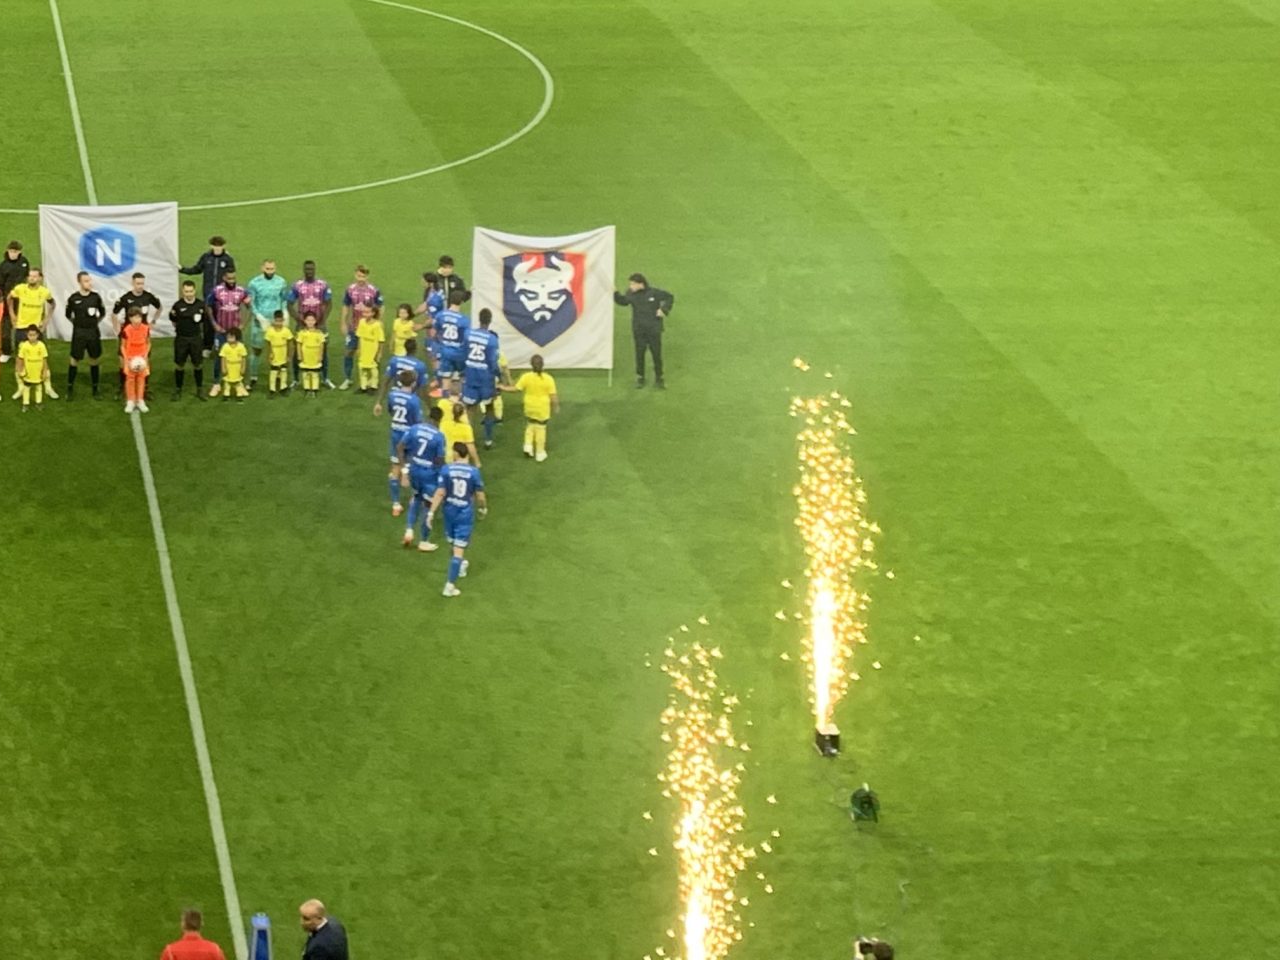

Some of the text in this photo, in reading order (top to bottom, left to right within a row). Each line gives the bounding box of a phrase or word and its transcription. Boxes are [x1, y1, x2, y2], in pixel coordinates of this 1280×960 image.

[95, 238, 122, 267] N
[442, 324, 459, 340] 26
[468, 343, 486, 361] 25
[392, 405, 407, 422] 22
[418, 438, 428, 456] 7
